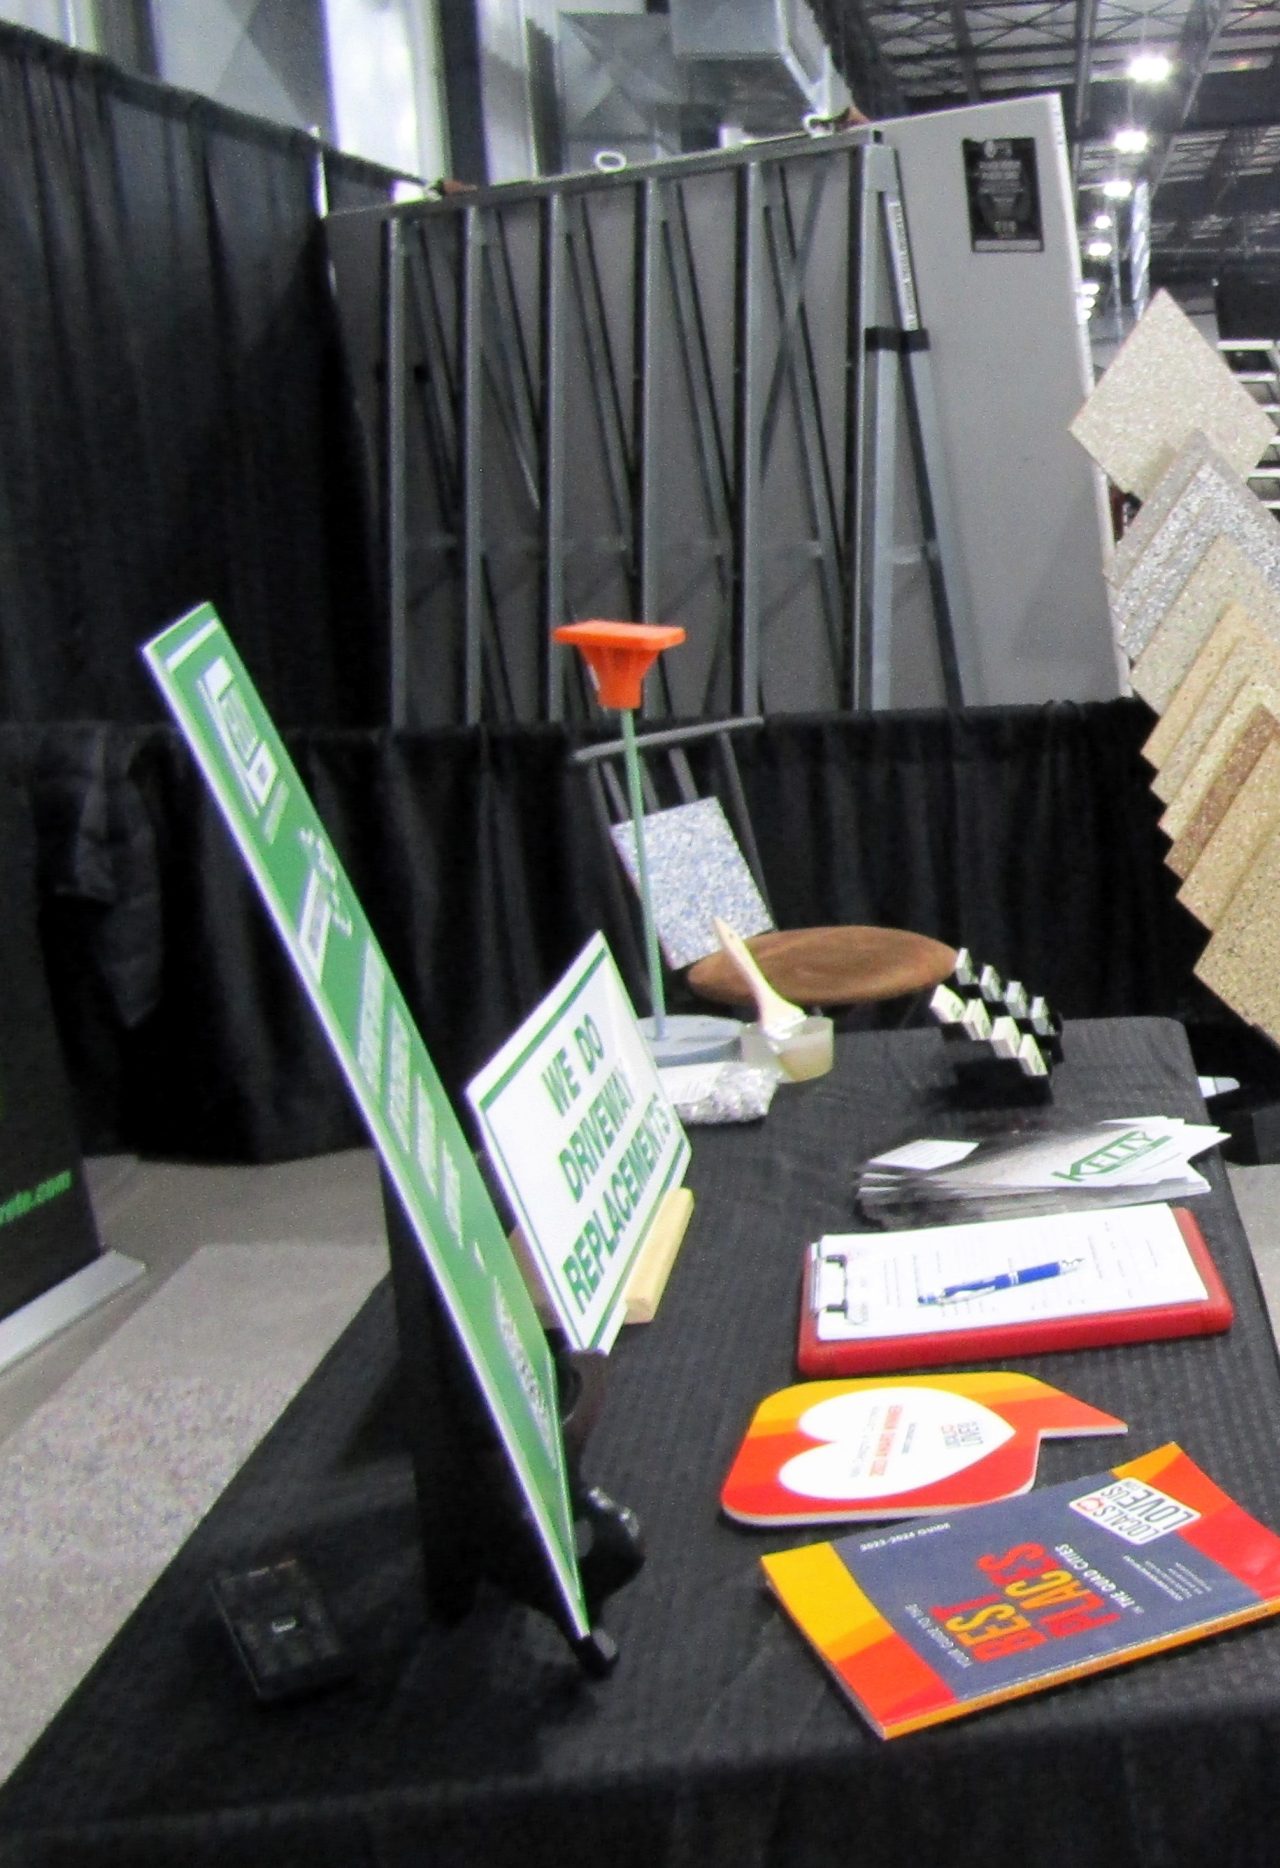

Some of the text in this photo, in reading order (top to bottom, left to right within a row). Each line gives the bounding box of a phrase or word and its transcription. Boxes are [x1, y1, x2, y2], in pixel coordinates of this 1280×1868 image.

[541, 1013, 604, 1117] WE DO
[559, 1060, 634, 1204] DRIVEWAY
[562, 1091, 672, 1316] REPLACEMENTS
[1093, 1505, 1159, 1542] LOCALS
[1101, 1485, 1194, 1531] LOVE US
[1054, 1543, 1089, 1571] CITIES
[1083, 1569, 1117, 1593] QUAD
[976, 1541, 1121, 1639] PLACES
[1109, 1590, 1136, 1609] THE
[928, 1593, 1049, 1663] BEST
